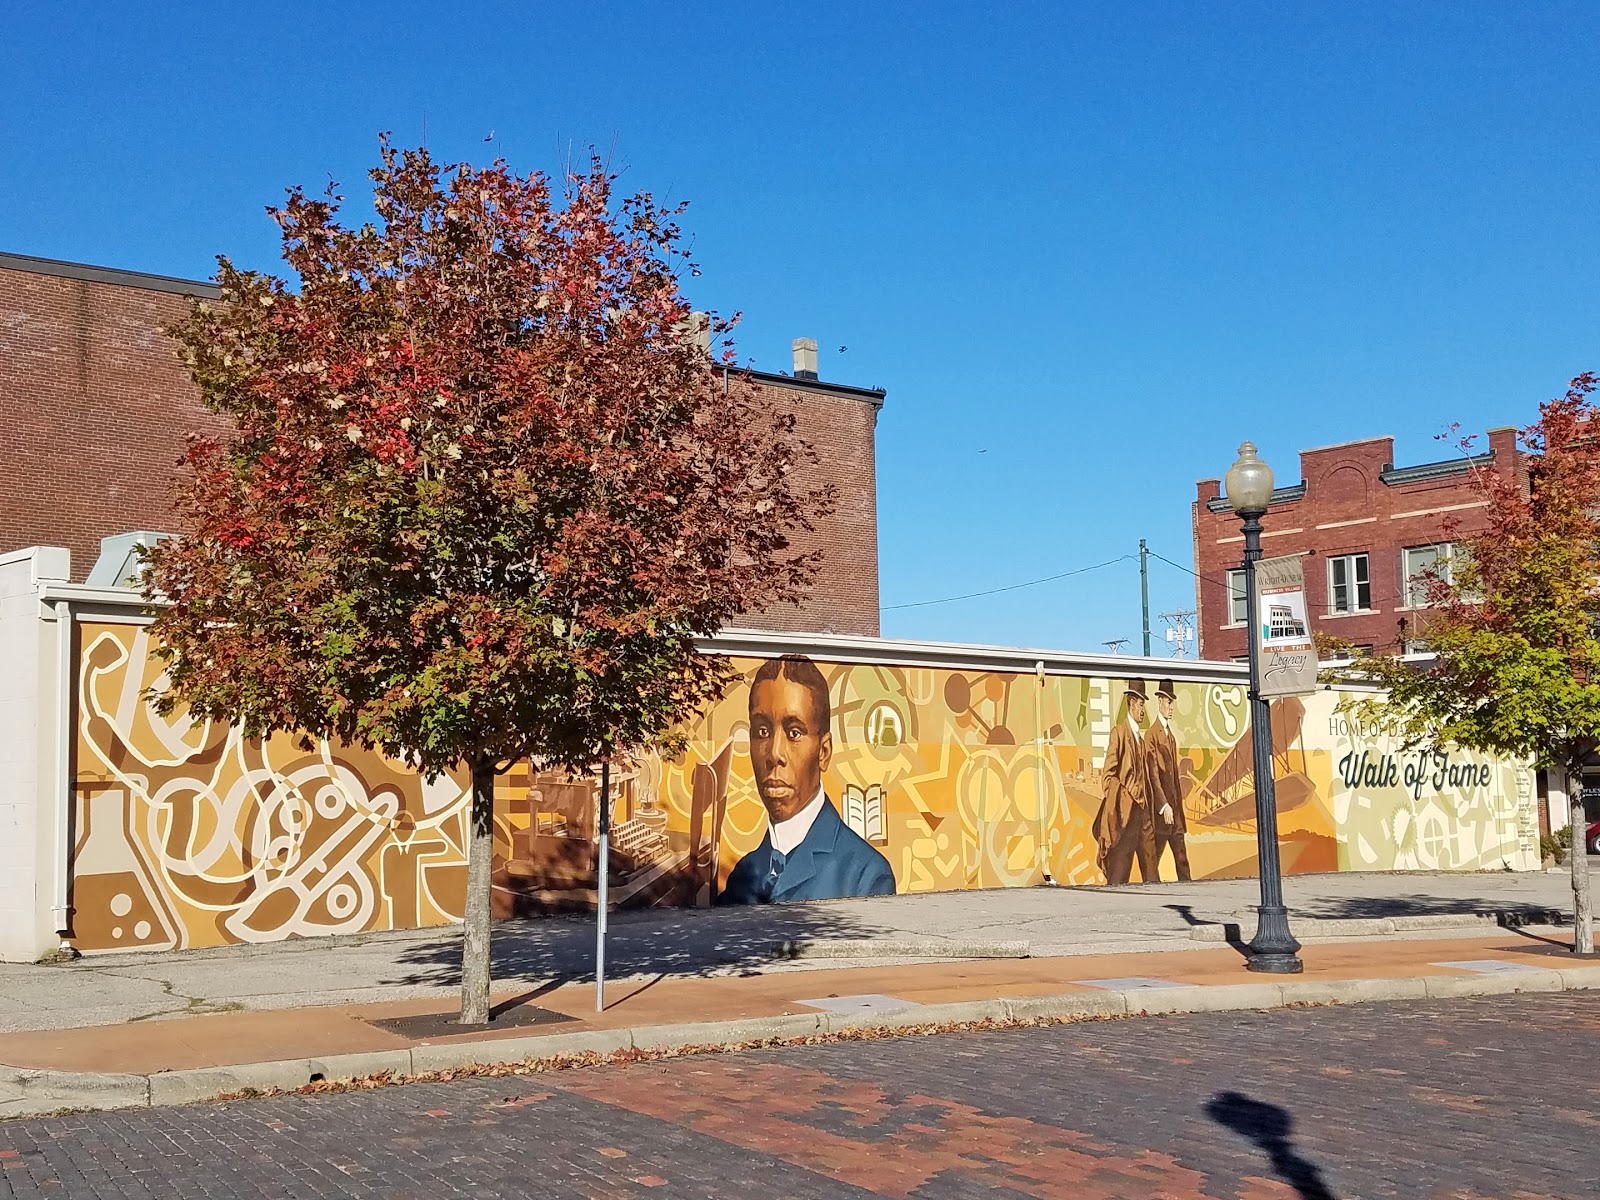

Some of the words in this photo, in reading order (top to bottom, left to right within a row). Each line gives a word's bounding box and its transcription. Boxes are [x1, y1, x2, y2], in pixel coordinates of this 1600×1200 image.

[1268, 652, 1306, 675] Legacy
[1328, 717, 1366, 737] HOME
[1338, 749, 1400, 789] Walk
[1405, 749, 1428, 801] of
[1432, 750, 1492, 791] Fame
